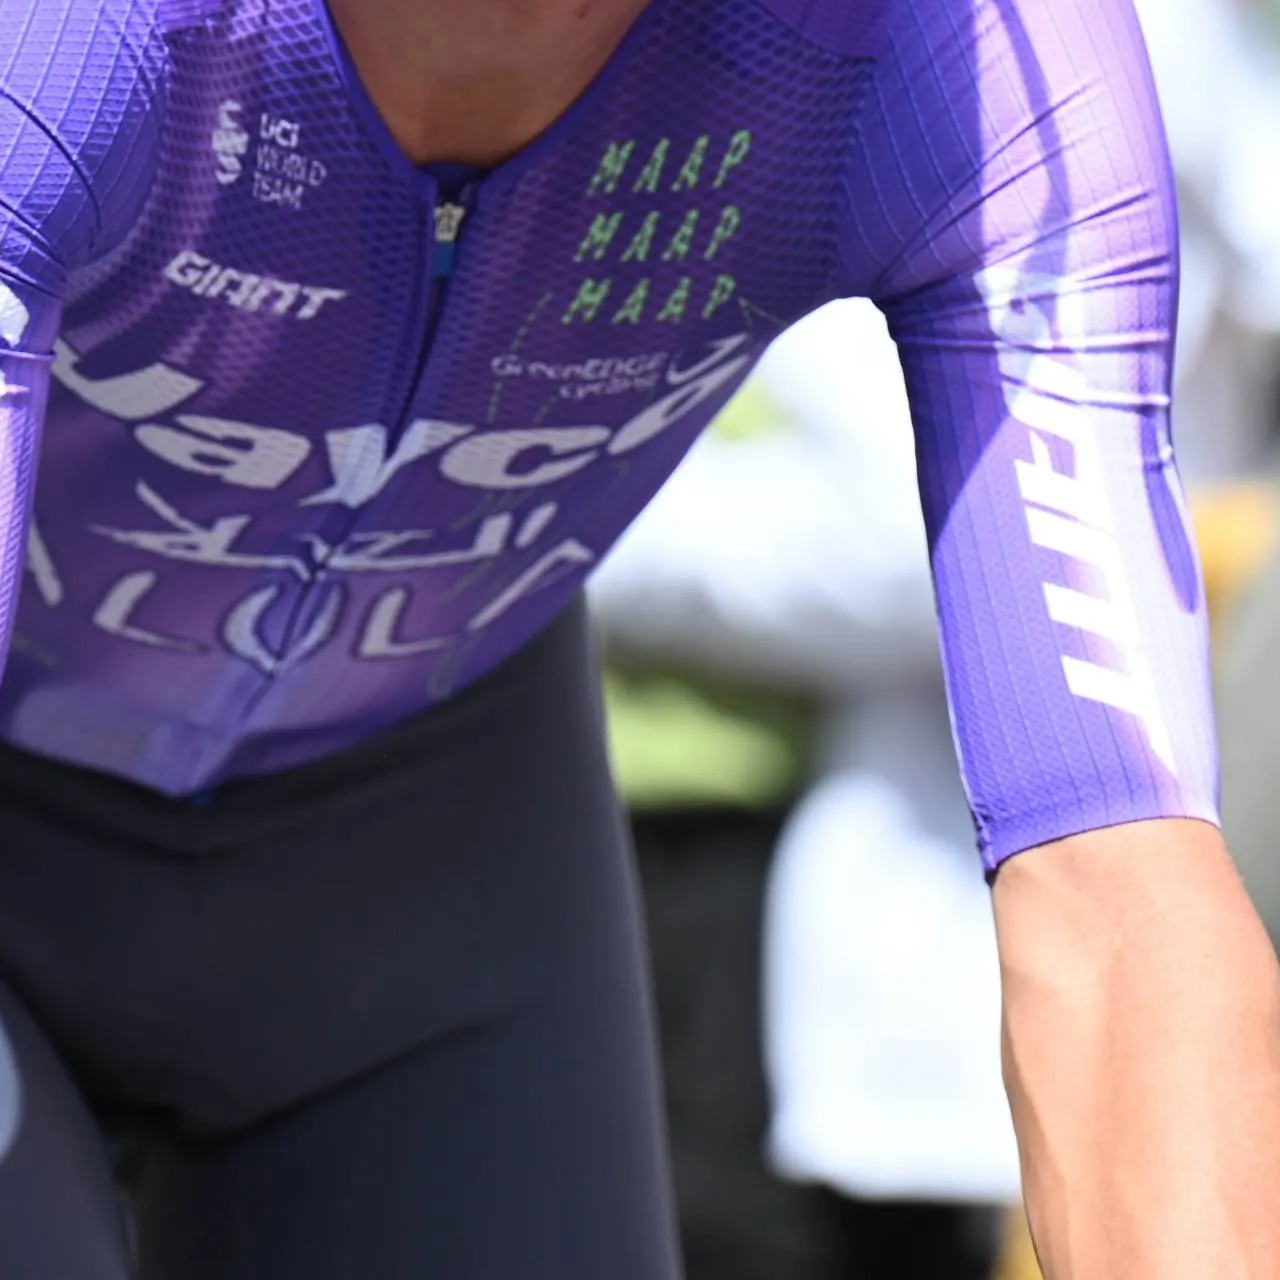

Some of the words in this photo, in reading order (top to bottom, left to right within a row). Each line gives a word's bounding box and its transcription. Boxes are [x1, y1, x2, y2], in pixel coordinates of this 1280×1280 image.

[585, 129, 751, 197] MAAP
[572, 204, 740, 263] MAAP
[164, 249, 352, 320] GIANT
[560, 273, 736, 325] MAAP
[973, 264, 1177, 781] GIANT
